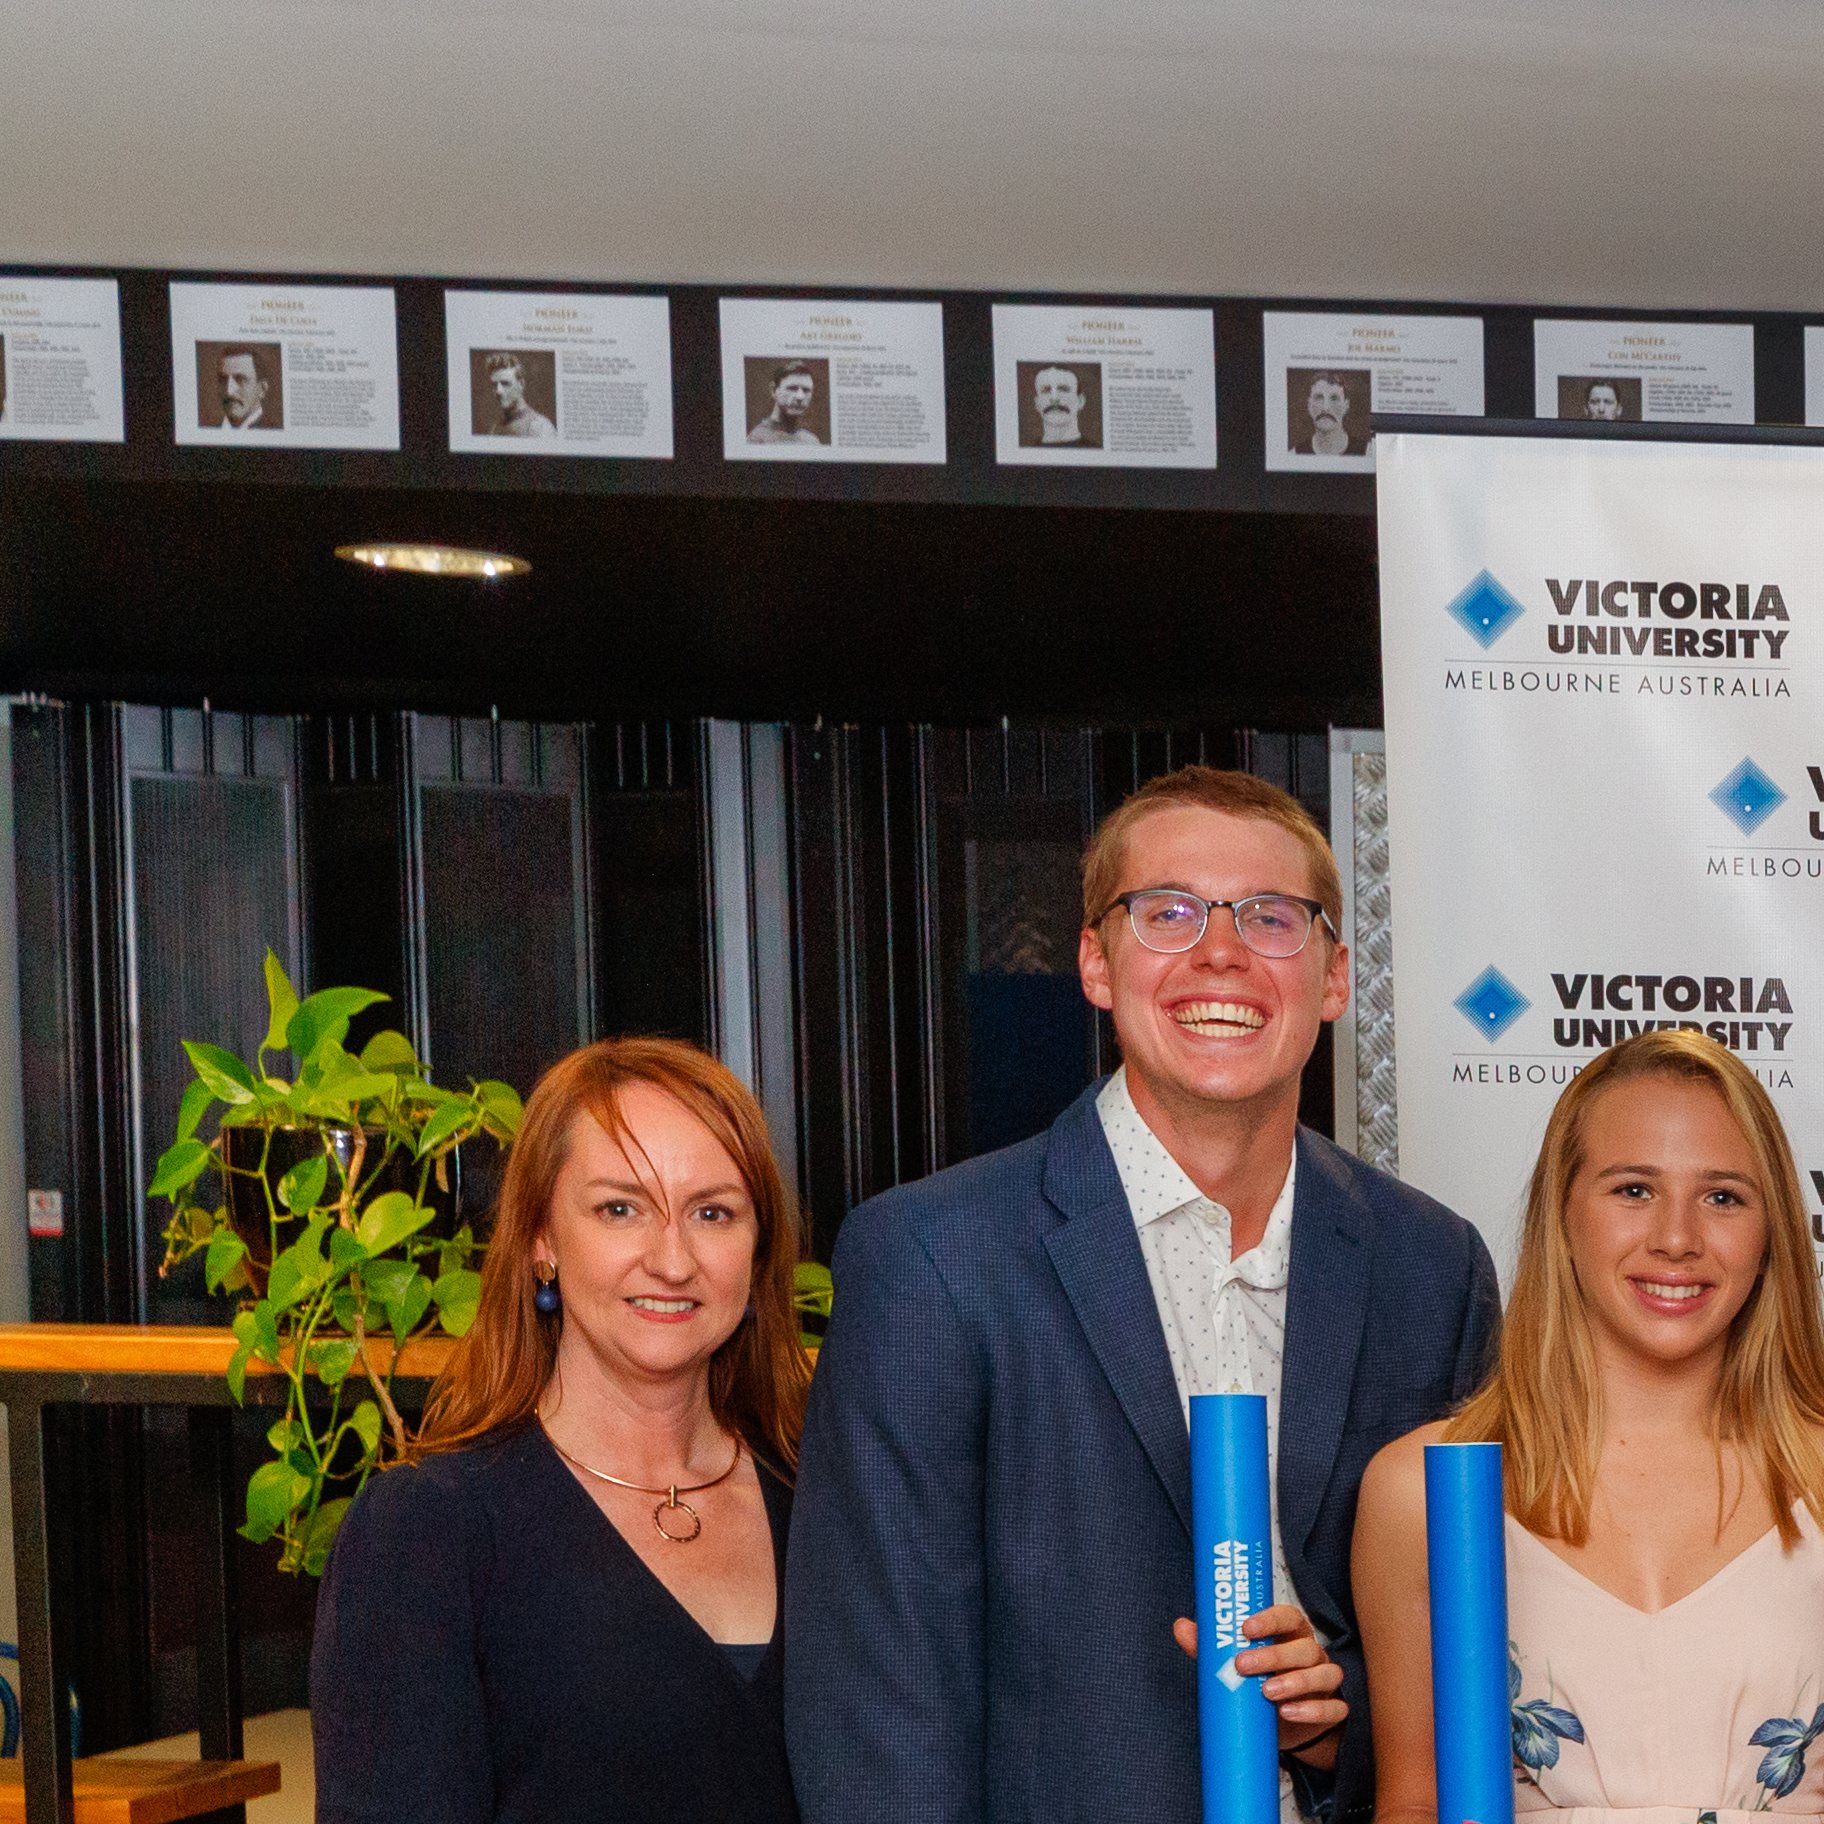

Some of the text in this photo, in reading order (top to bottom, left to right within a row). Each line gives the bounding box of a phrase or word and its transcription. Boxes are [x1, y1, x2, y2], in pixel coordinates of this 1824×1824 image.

[1545, 579, 1790, 621] VICTORIA
[1547, 625, 1790, 660] UNIVERSITY
[1444, 669, 1791, 698] MELBOURNE AUSTRALIA
[1551, 973, 1793, 1014] VICTORIA
[1213, 1539, 1232, 1649] VICTORIA
[1255, 1540, 1264, 1610] AUSTRALIA
